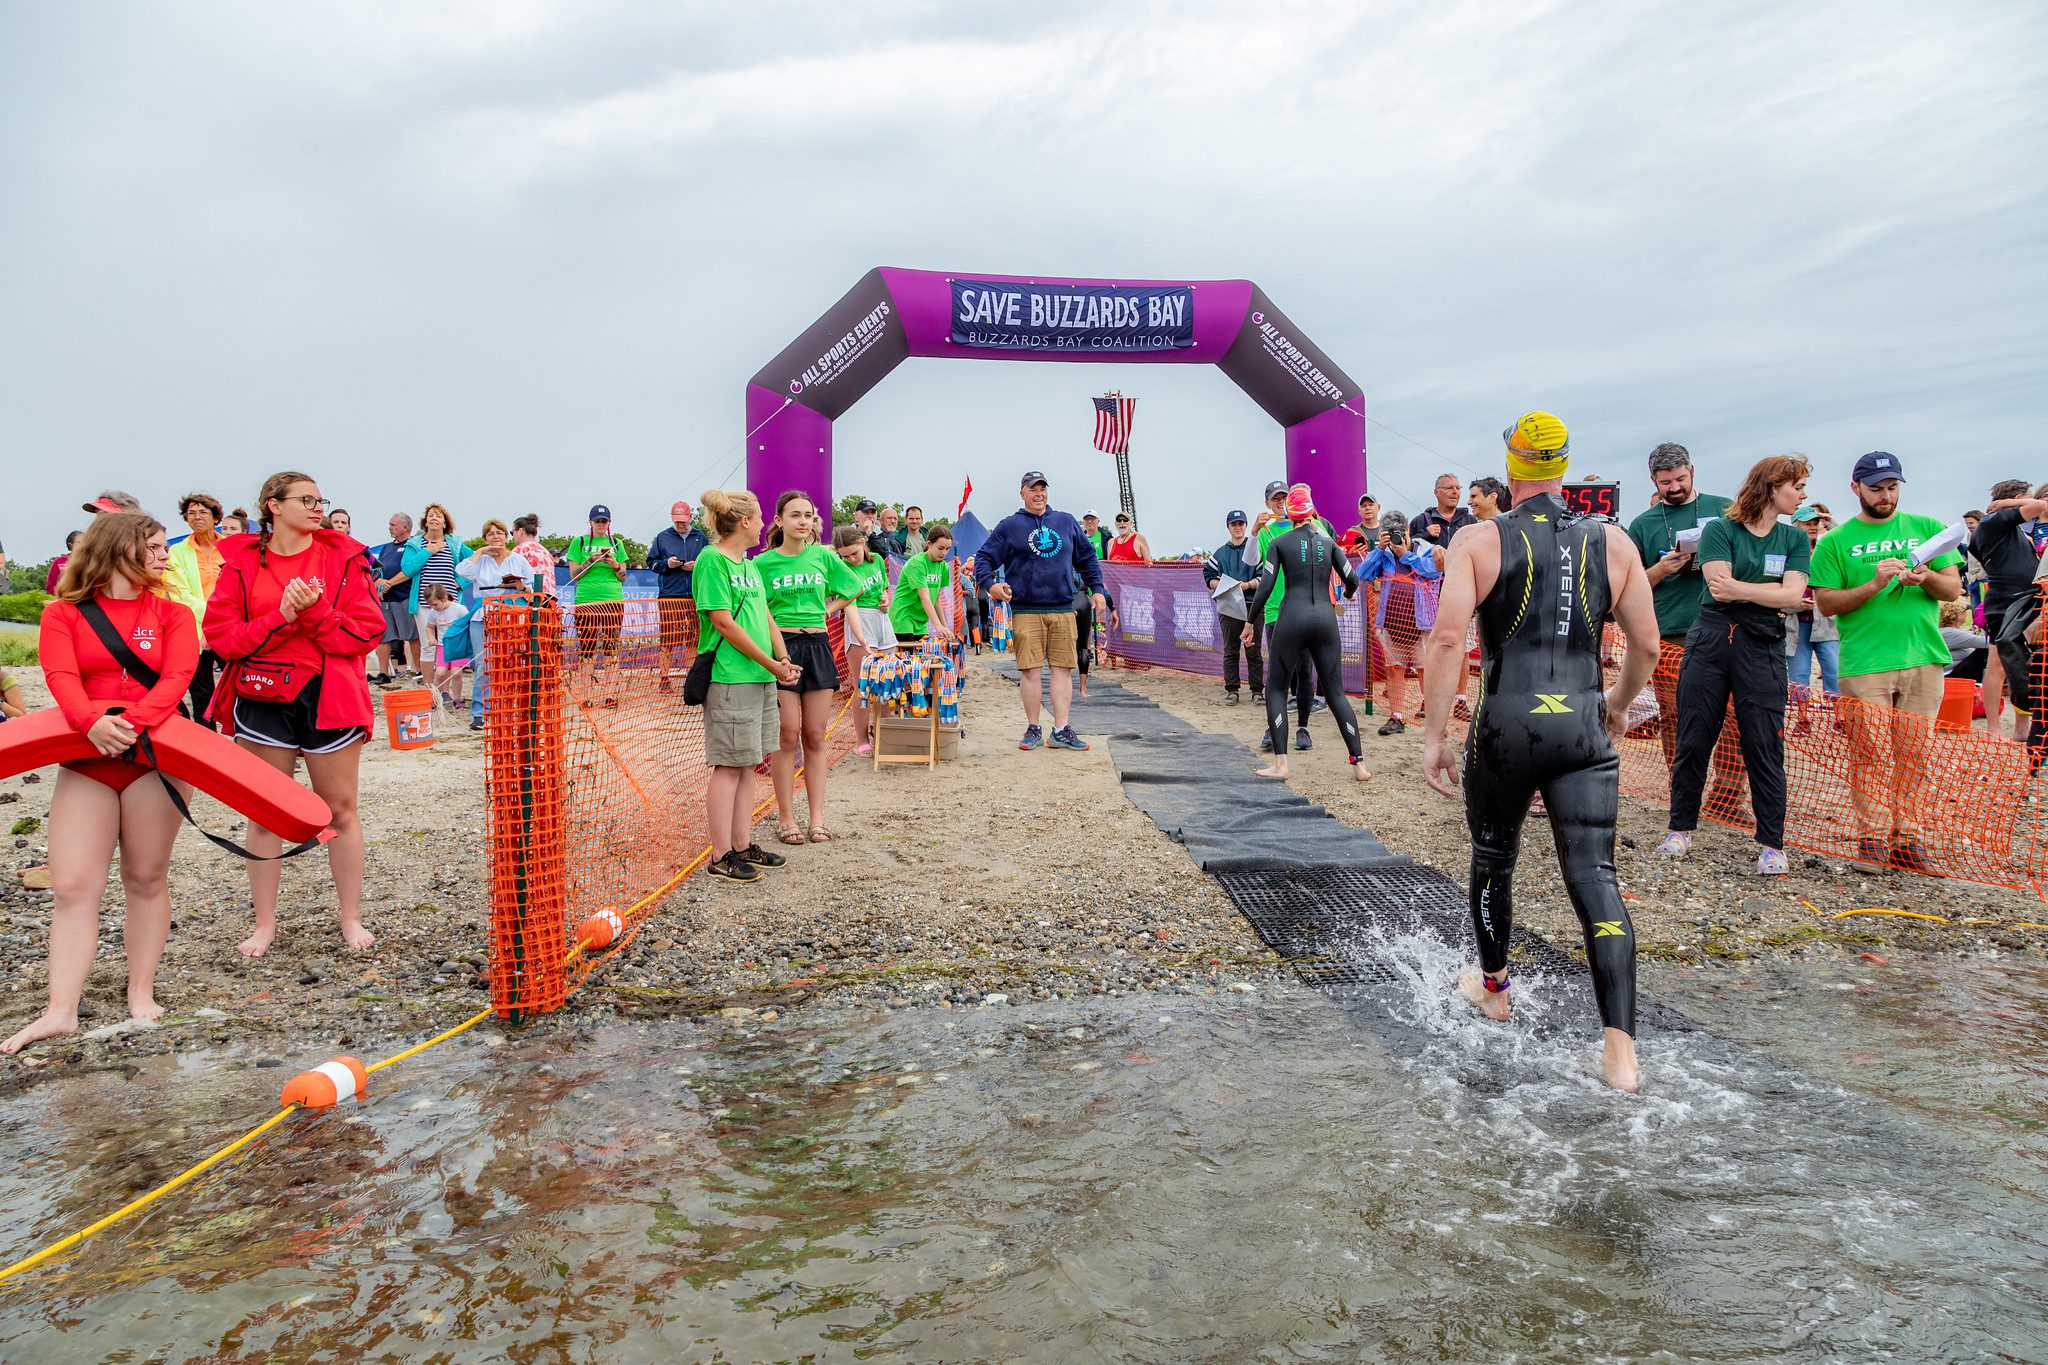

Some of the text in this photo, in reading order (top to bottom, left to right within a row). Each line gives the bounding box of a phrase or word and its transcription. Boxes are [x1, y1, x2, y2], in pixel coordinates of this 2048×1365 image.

[960, 289, 1185, 328] SAVE BUZZARDS BAY
[801, 301, 890, 387] ALL SPORTS EVENTS
[813, 320, 887, 387] TIMING AND EVENT SERVICES
[825, 332, 884, 385] www.allsportsevents.com
[969, 331, 1175, 348] BUZZARDS BAY COALITION
[1259, 322, 1343, 400] ALL SPORTS EVENTS
[1276, 349, 1289, 361] AND
[1287, 359, 1305, 375] EVENT
[1302, 374, 1327, 397] SERVICES
[1851, 538, 1919, 557] SERVE
[772, 573, 823, 590] SERVE
[1557, 545, 1573, 636] XTERRA
[1481, 889, 1495, 932] XTERRA
